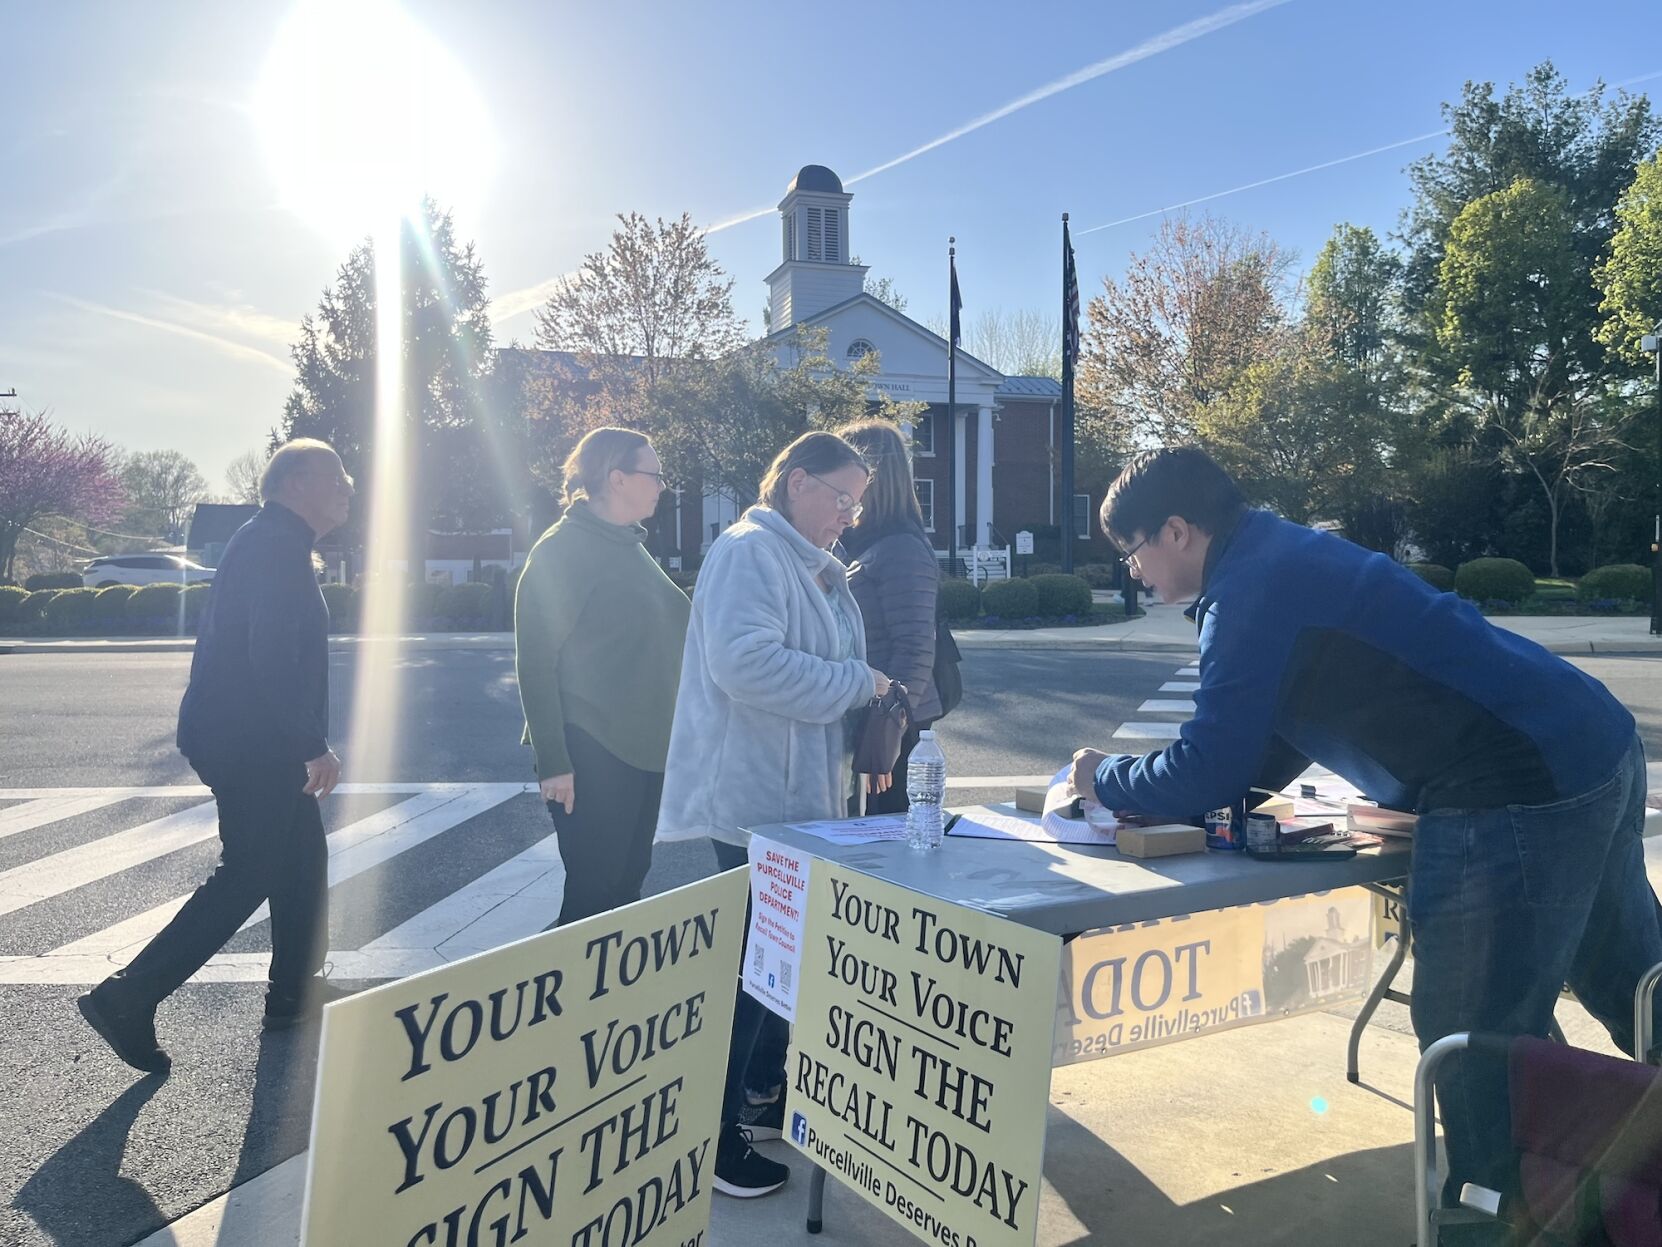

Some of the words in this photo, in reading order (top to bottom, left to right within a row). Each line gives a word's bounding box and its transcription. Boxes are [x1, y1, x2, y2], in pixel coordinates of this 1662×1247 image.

[891, 383, 911, 391] HALL
[757, 862, 805, 891] PURCELLVILLE
[766, 850, 784, 866] SAVE
[784, 858, 799, 872] THE
[771, 881, 792, 901] POLICE
[830, 878, 900, 944] YOUR
[912, 908, 1024, 989] TOWN
[395, 969, 564, 1082] YOUR
[585, 908, 719, 1001] TOWN
[826, 936, 898, 1007] YOUR
[910, 971, 1013, 1058] VOICE
[388, 1066, 557, 1195] YOUR
[580, 991, 706, 1089] VOICE
[825, 1005, 901, 1082] SIGN
[911, 1046, 994, 1133] THE
[580, 1076, 684, 1195] THE
[795, 1050, 896, 1152] RECALL
[906, 1115, 1028, 1231] TODAY
[808, 1128, 881, 1198] Purcellville
[885, 1181, 960, 1247] Deserves
